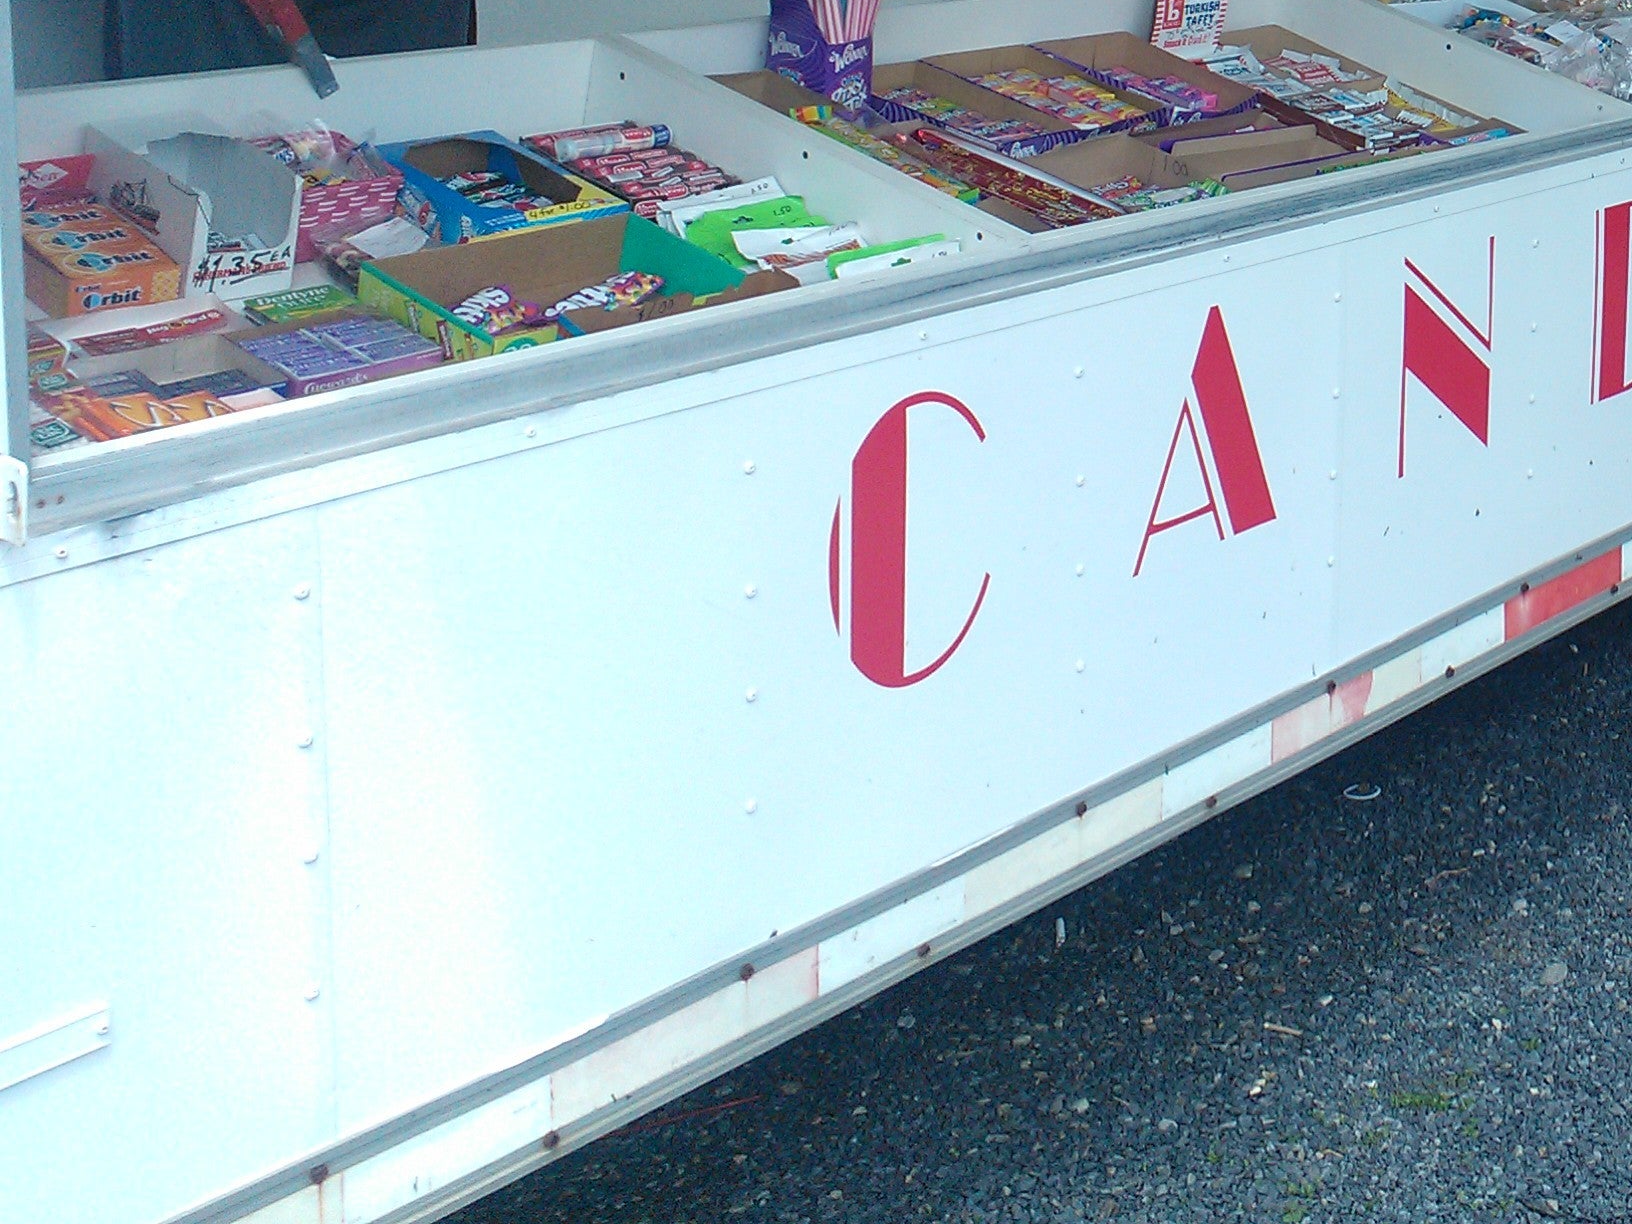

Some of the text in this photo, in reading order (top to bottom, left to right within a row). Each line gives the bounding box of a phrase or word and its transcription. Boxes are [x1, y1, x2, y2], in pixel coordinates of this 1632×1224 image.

[1184, 0, 1221, 15] TURKISH
[1185, 13, 1216, 27] TAFFY
[83, 288, 142, 310] Orbit
